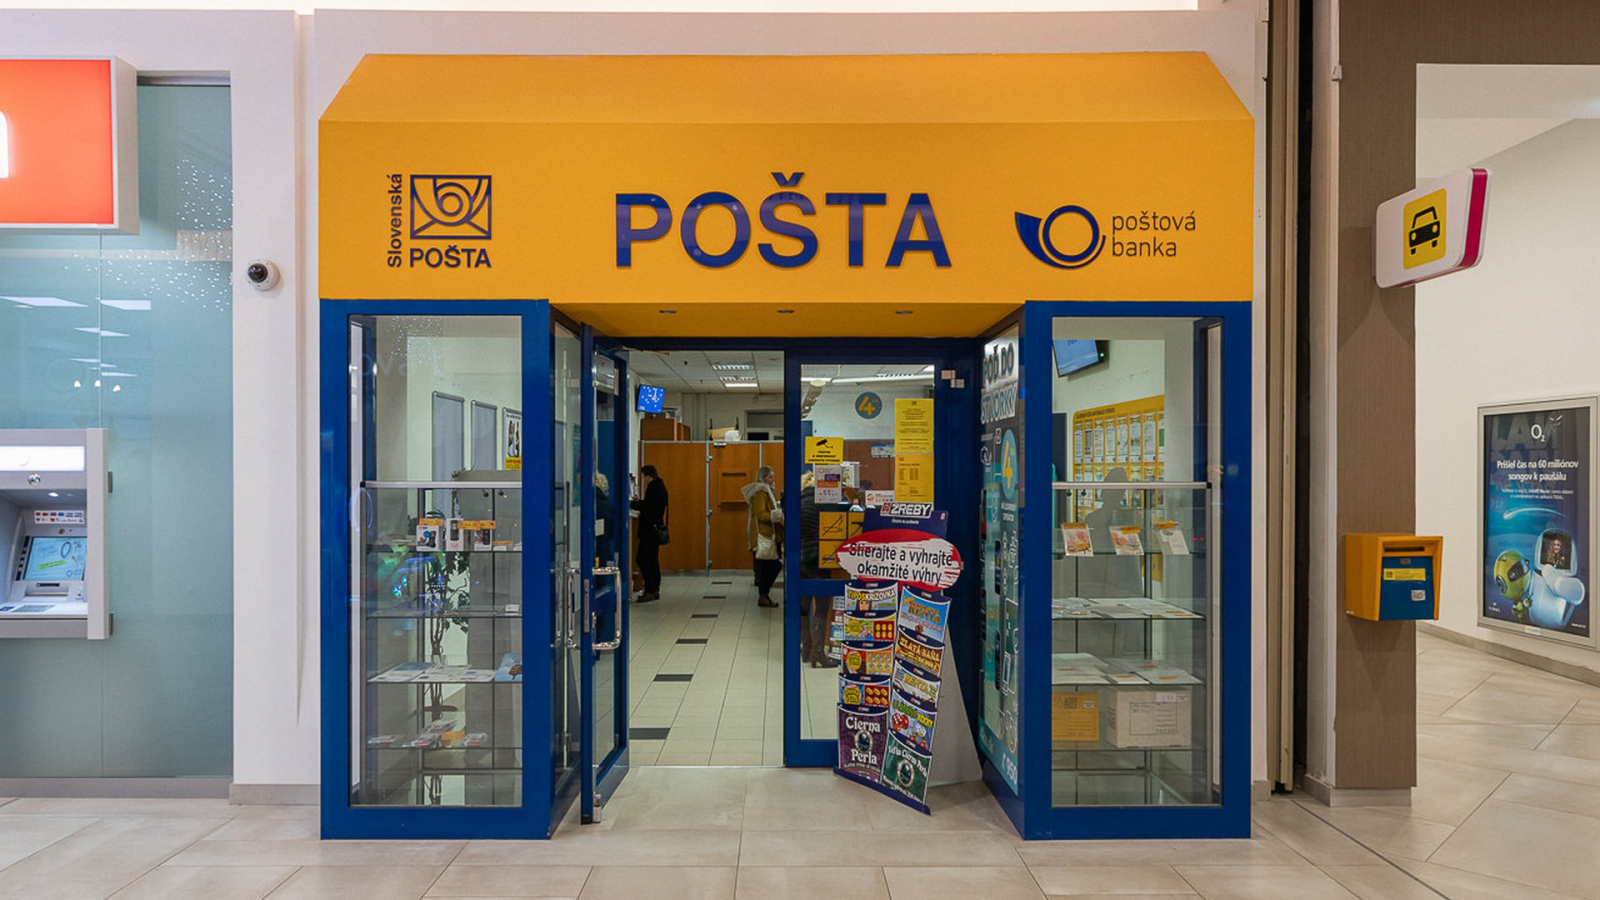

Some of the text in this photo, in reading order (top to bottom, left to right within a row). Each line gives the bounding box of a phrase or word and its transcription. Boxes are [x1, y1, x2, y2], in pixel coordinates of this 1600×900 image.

[387, 173, 403, 268] Slovenská
[615, 171, 952, 268] POŠTA
[1112, 210, 1196, 236] poštová
[409, 244, 492, 268] POŠTA
[1112, 236, 1177, 257] banka
[1001, 342, 1015, 377] DO
[1528, 461, 1537, 469] na
[1538, 460, 1547, 469] 60
[1508, 473, 1532, 483] songov
[1533, 472, 1539, 481] k
[849, 543, 952, 568] Stierajte a vyhrajte
[857, 561, 942, 587] okamžité výhry
[851, 748, 878, 765] Perla
